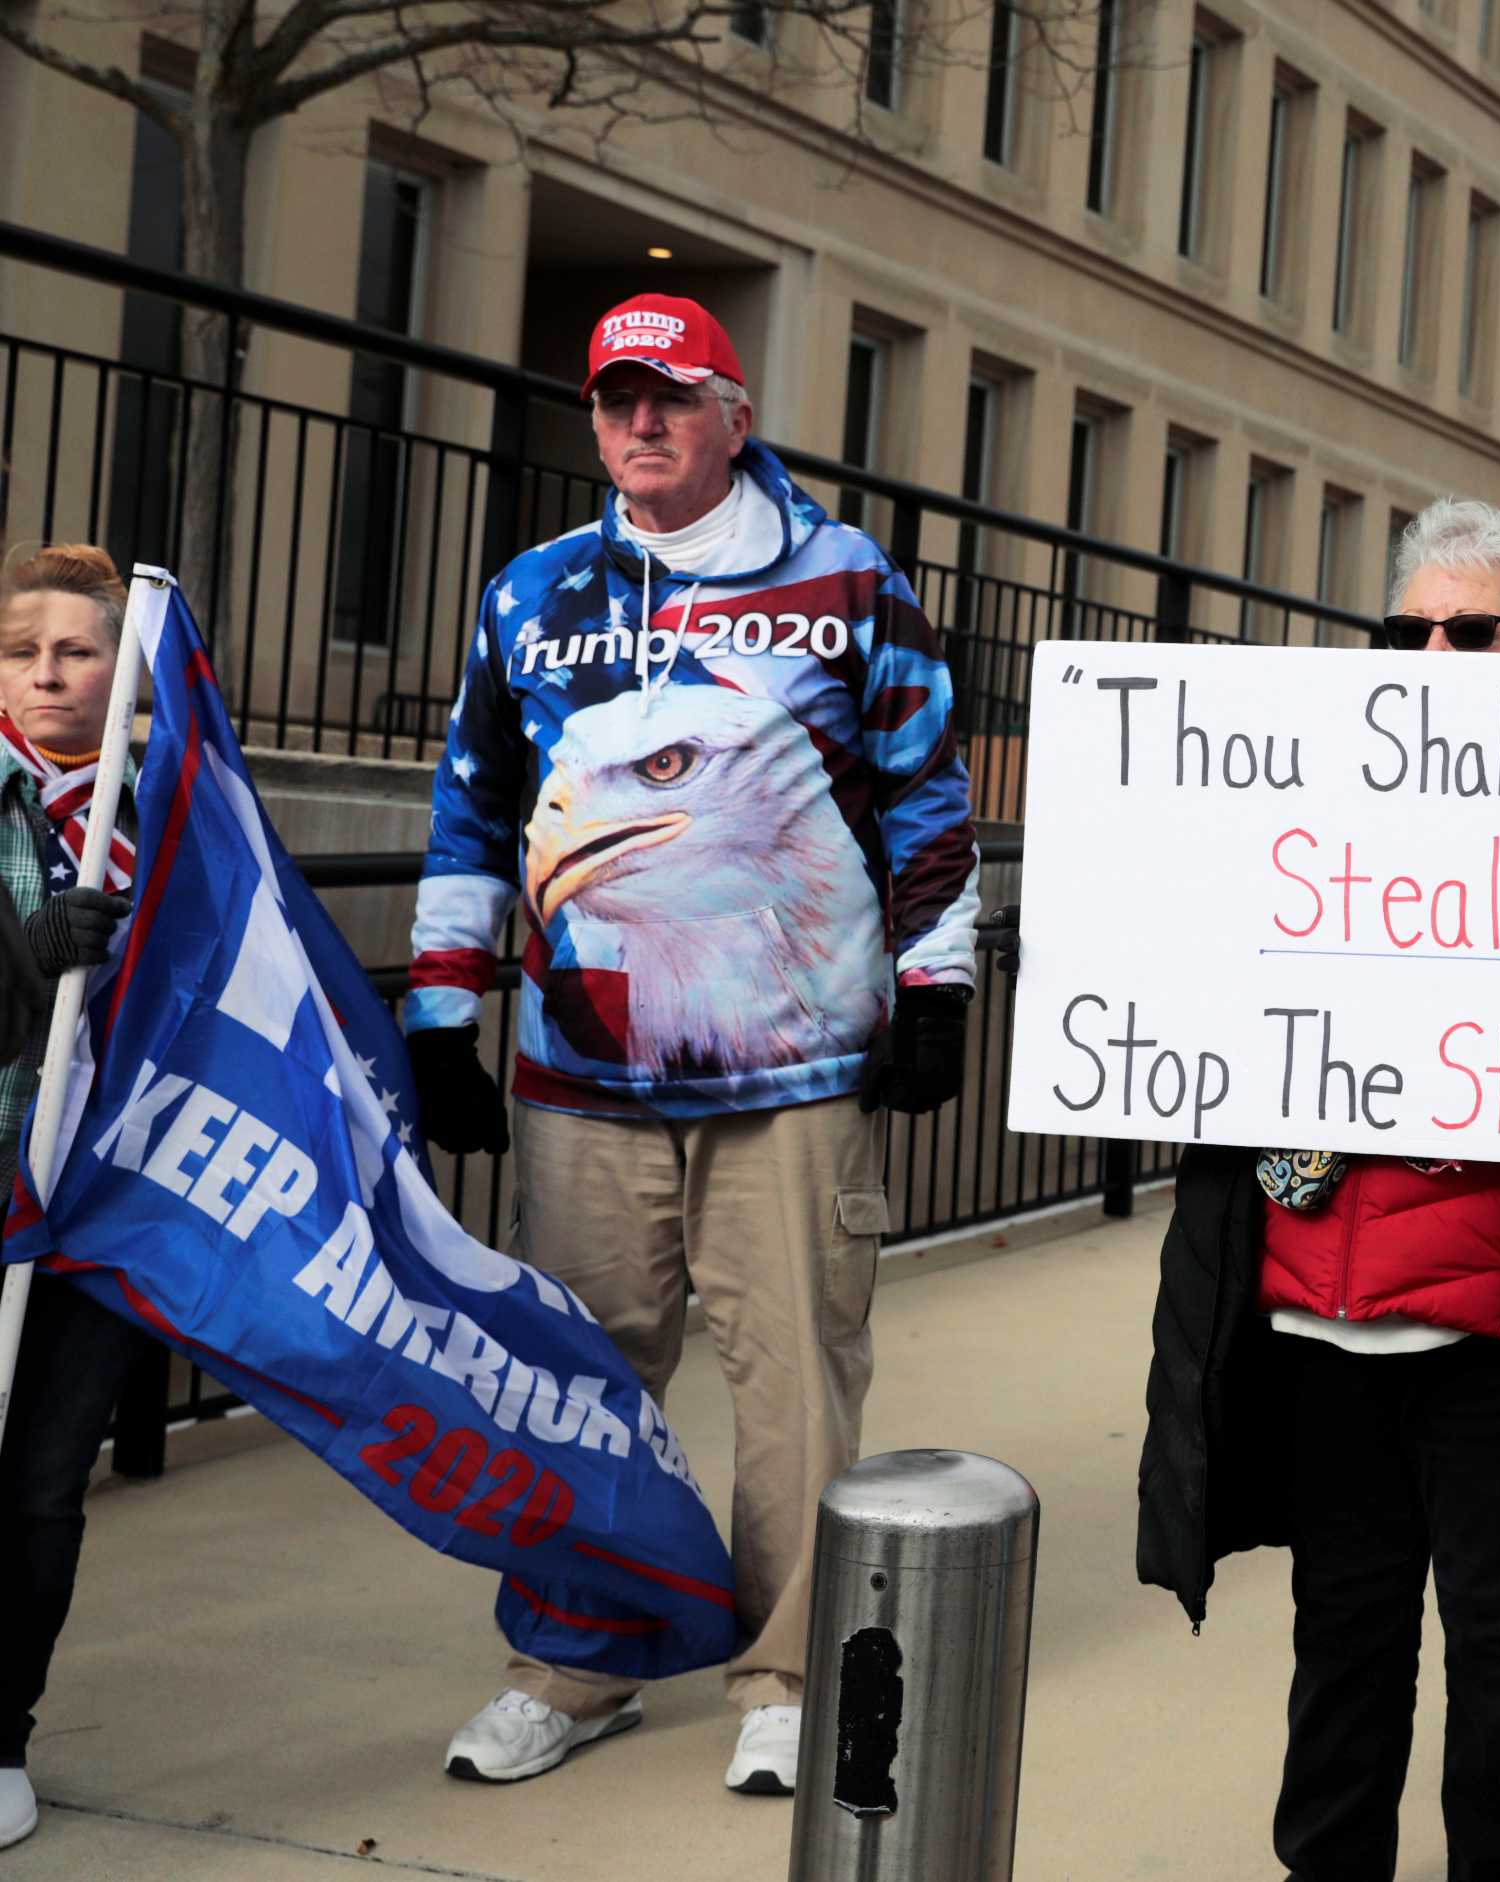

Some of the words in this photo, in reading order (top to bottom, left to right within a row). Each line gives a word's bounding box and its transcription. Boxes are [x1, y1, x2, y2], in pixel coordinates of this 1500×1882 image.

[603, 311, 686, 339] Trump
[612, 335, 672, 351] 2020
[507, 626, 679, 683] rump
[695, 612, 848, 660] 2020
[1053, 994, 1229, 1138] Stop
[1264, 1008, 1403, 1130] The
[92, 1058, 318, 1242] KEEP
[358, 1404, 574, 1548] 2020
